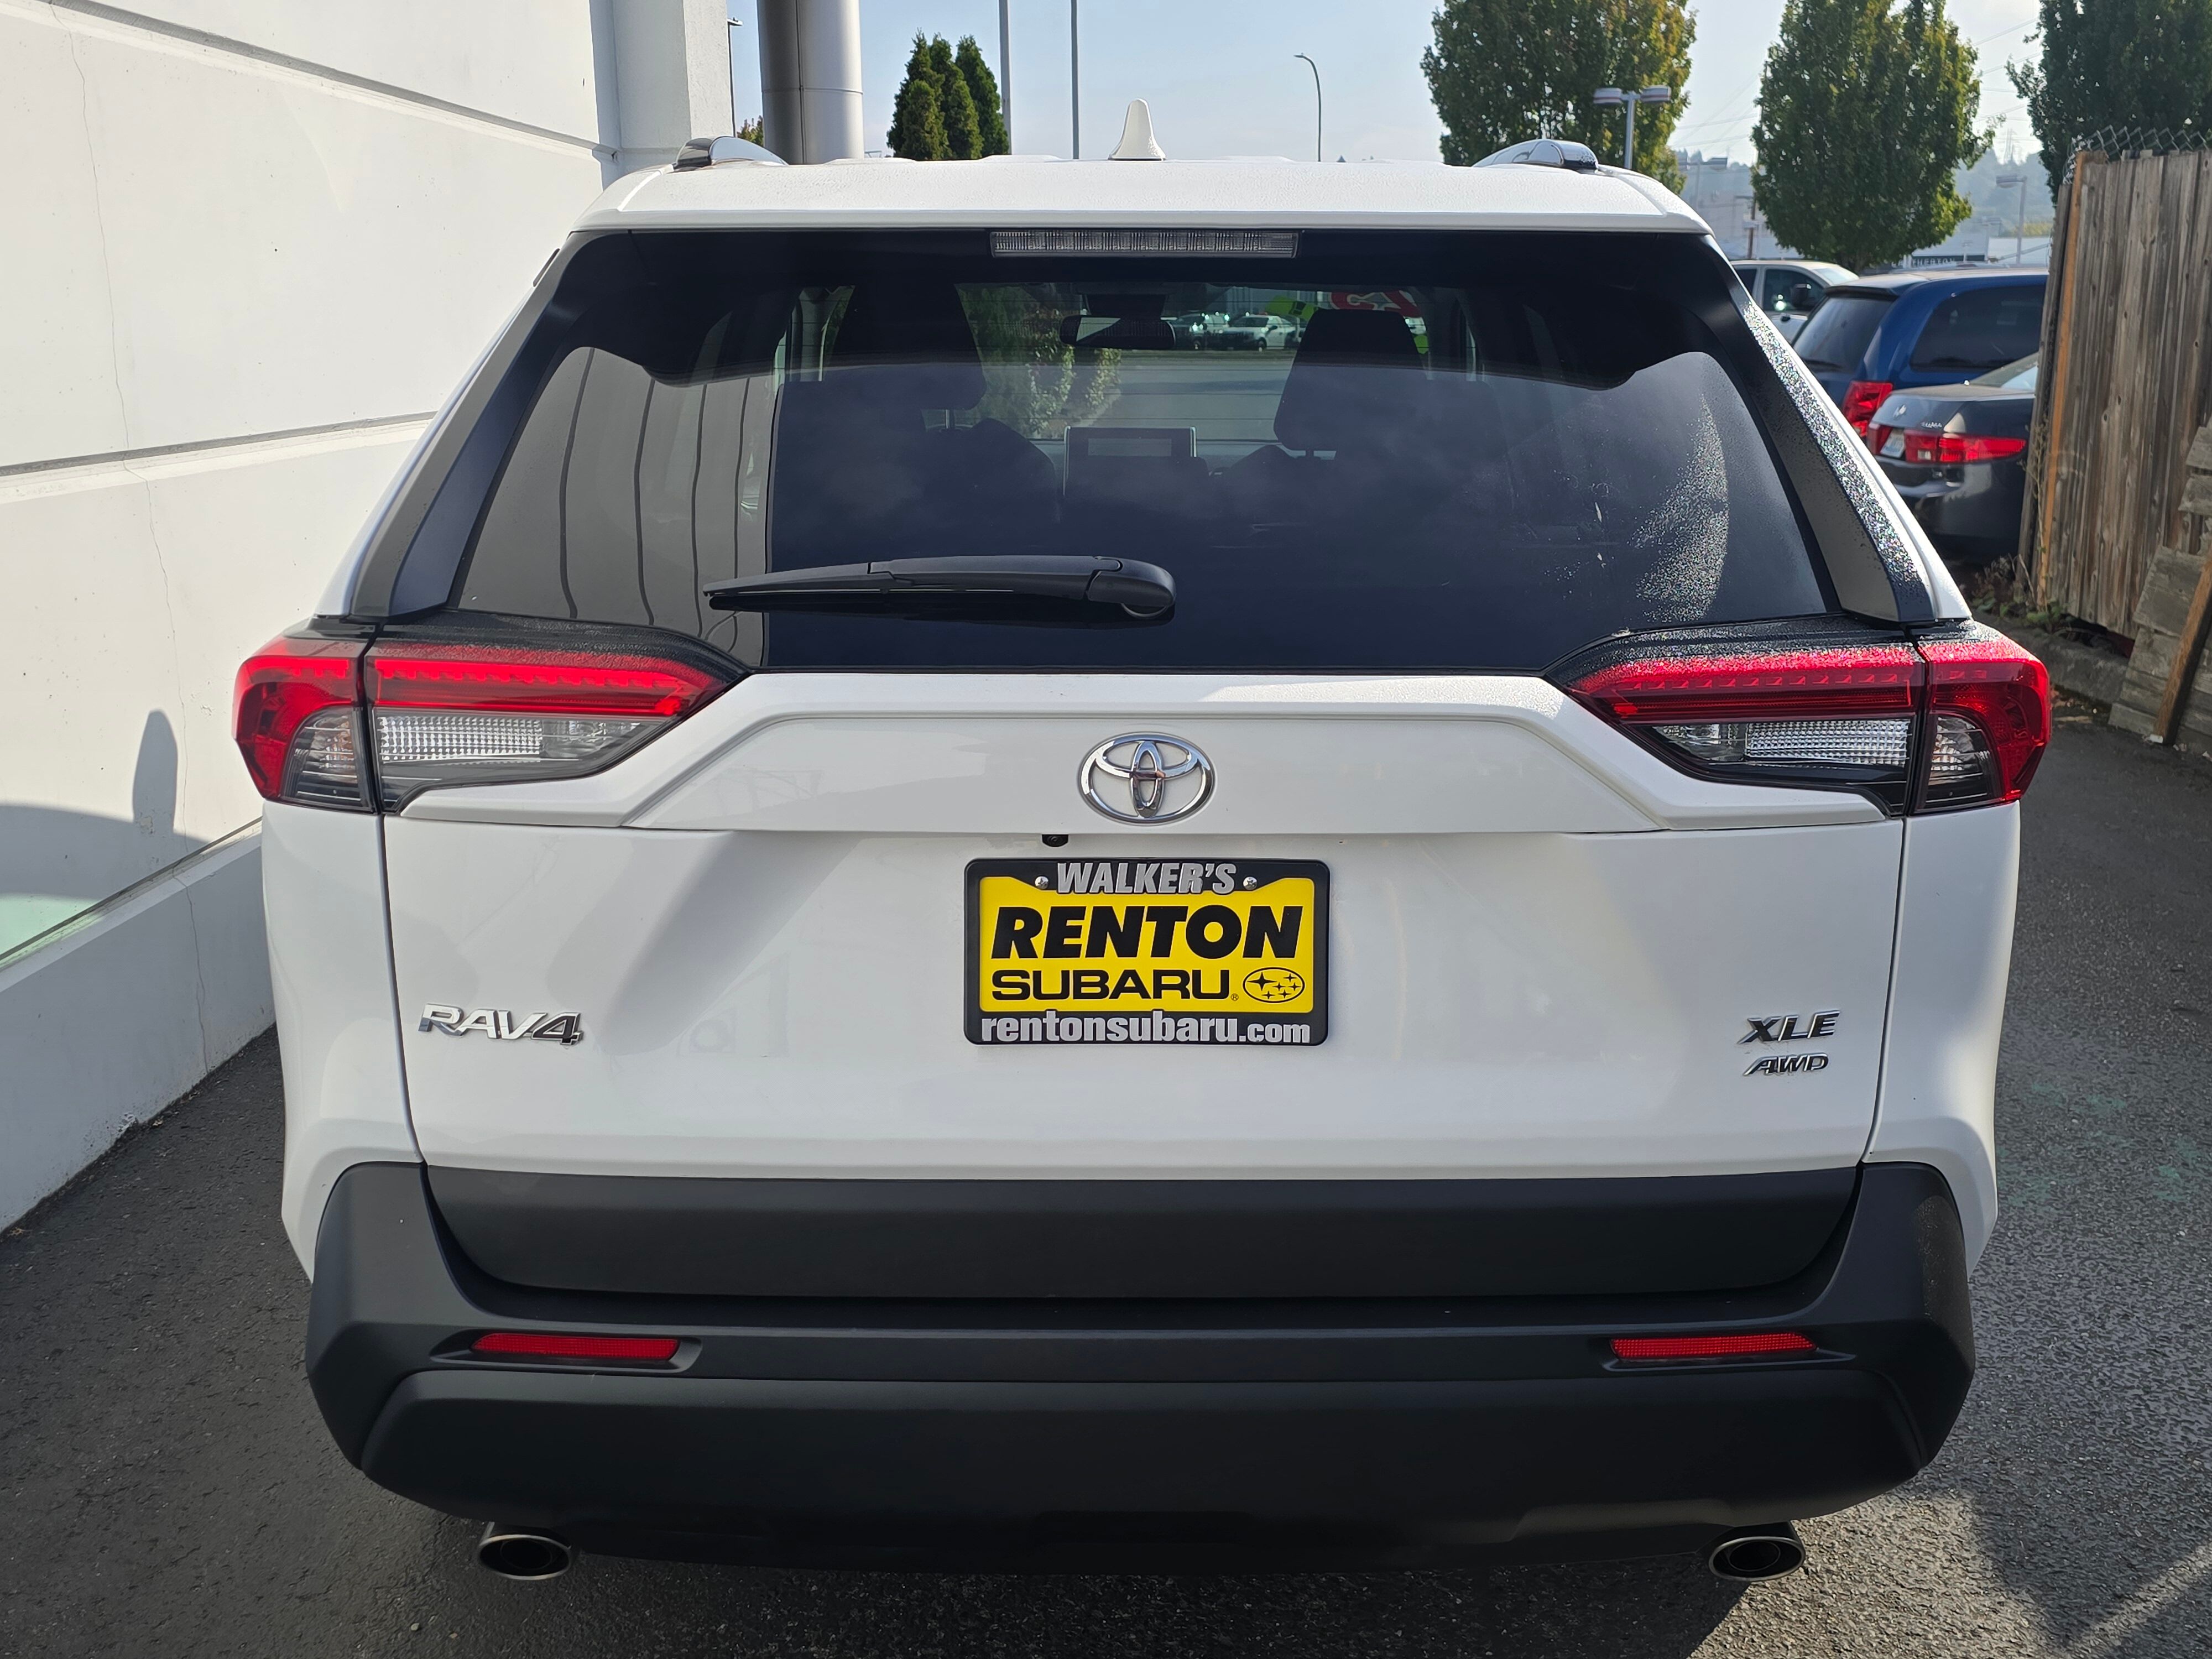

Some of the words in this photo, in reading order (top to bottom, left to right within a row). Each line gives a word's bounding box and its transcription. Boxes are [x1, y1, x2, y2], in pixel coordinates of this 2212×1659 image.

[1057, 862, 1237, 894] WALKER'S
[991, 905, 1303, 959] RENTON
[992, 969, 1229, 1000] SUBARU
[419, 1003, 584, 1046] RAV4
[981, 1011, 1310, 1043] rentonsubaru.com
[1736, 1009, 1840, 1044] XLE
[1744, 1052, 1829, 1076] AWD
